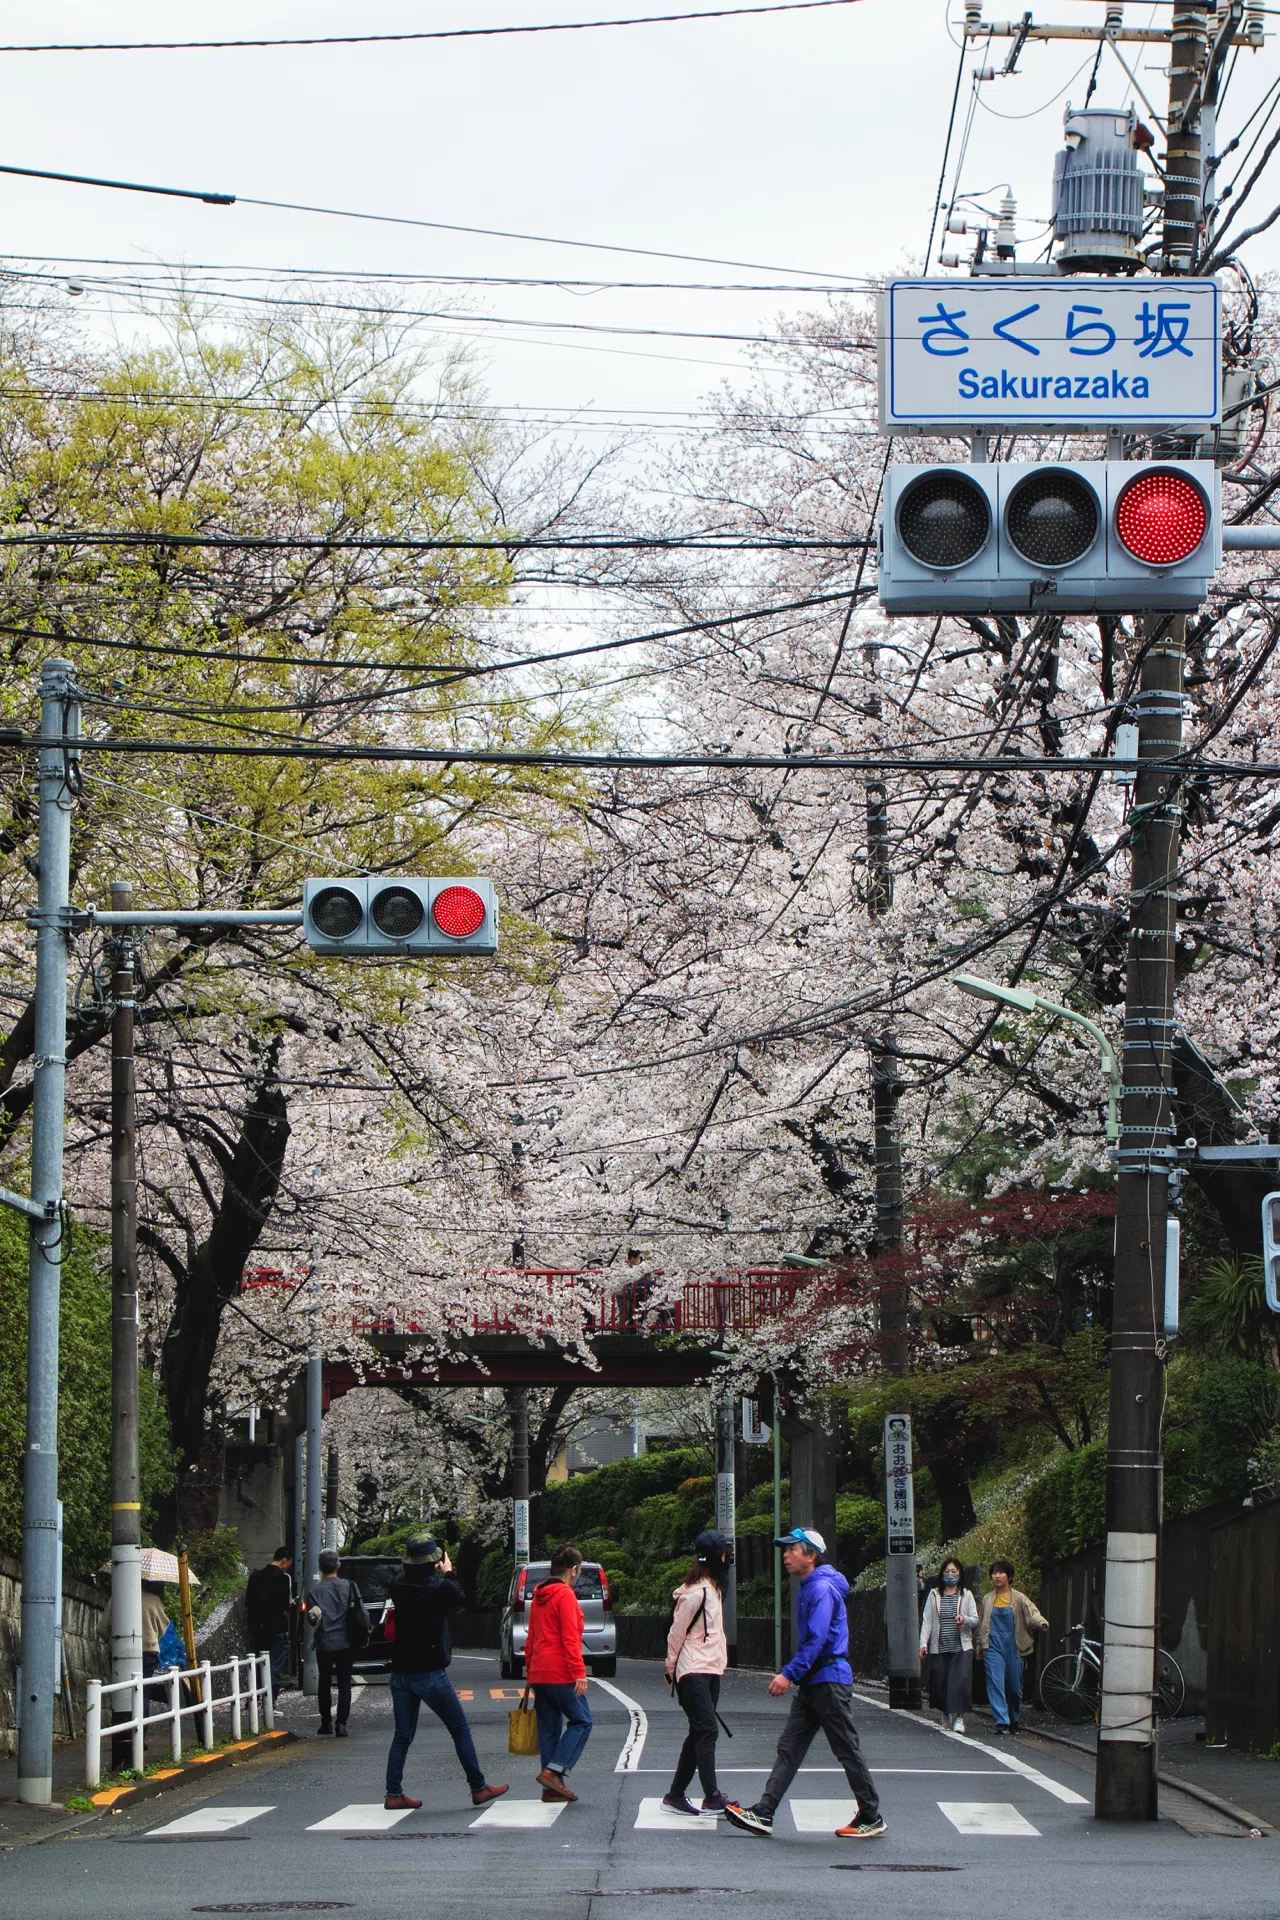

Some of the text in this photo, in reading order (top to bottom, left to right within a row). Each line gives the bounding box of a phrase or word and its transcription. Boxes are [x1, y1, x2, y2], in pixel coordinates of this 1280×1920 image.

[917, 301, 1193, 358] さくら坂
[958, 367, 1149, 399] Sakurazaka
